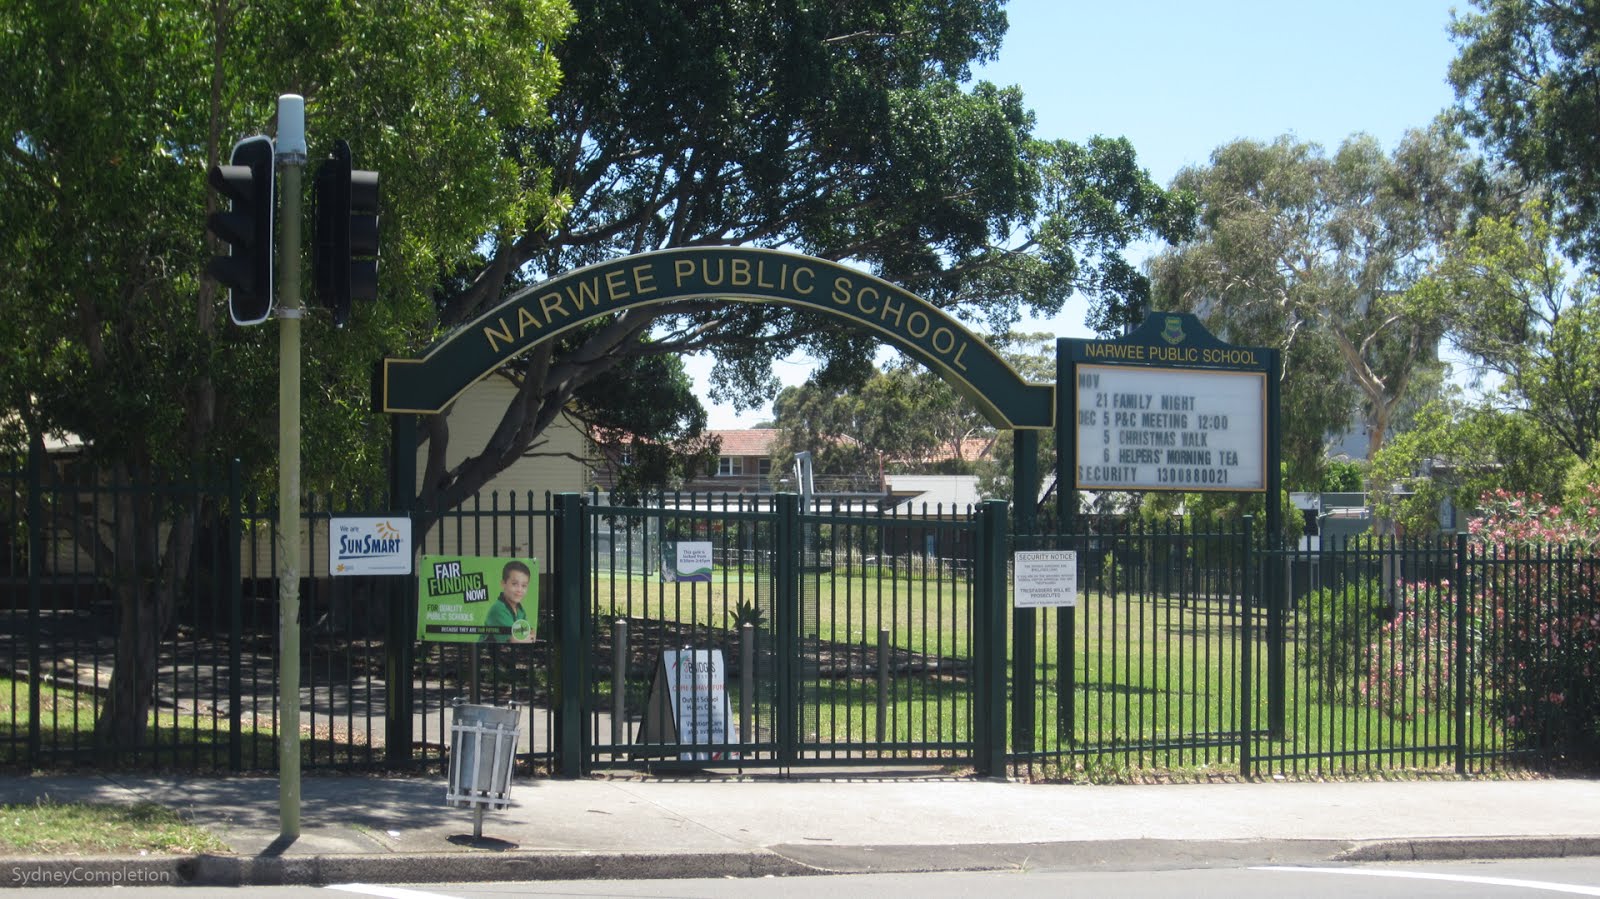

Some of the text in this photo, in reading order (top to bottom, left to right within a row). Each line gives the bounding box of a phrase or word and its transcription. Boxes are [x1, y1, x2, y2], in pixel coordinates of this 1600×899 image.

[483, 258, 969, 371] NARWEE PUBLIC SCHOOL
[1085, 343, 1259, 365] NARWEE PUBLIC SCHOOL
[1078, 373, 1100, 389] NOV
[1096, 393, 1195, 411] 21 FAMILY NIGHT
[1078, 410, 1228, 430] DEC 5 P&C MEETING 12:00
[1103, 430, 1208, 447] 5 CHRISTMAS WALK
[1103, 449, 1110, 463] 6
[1167, 450, 1211, 465] MORNING
[1220, 452, 1239, 466] TEA
[1078, 465, 1228, 484] SECURITY 1300880021
[340, 524, 348, 532] We
[435, 562, 460, 580] FAIR
[430, 574, 481, 595] FUNDING
[466, 589, 487, 601] NOW!
[427, 604, 463, 612] FOR QUALITY
[426, 612, 474, 622] PUBLIC SCHOOLS
